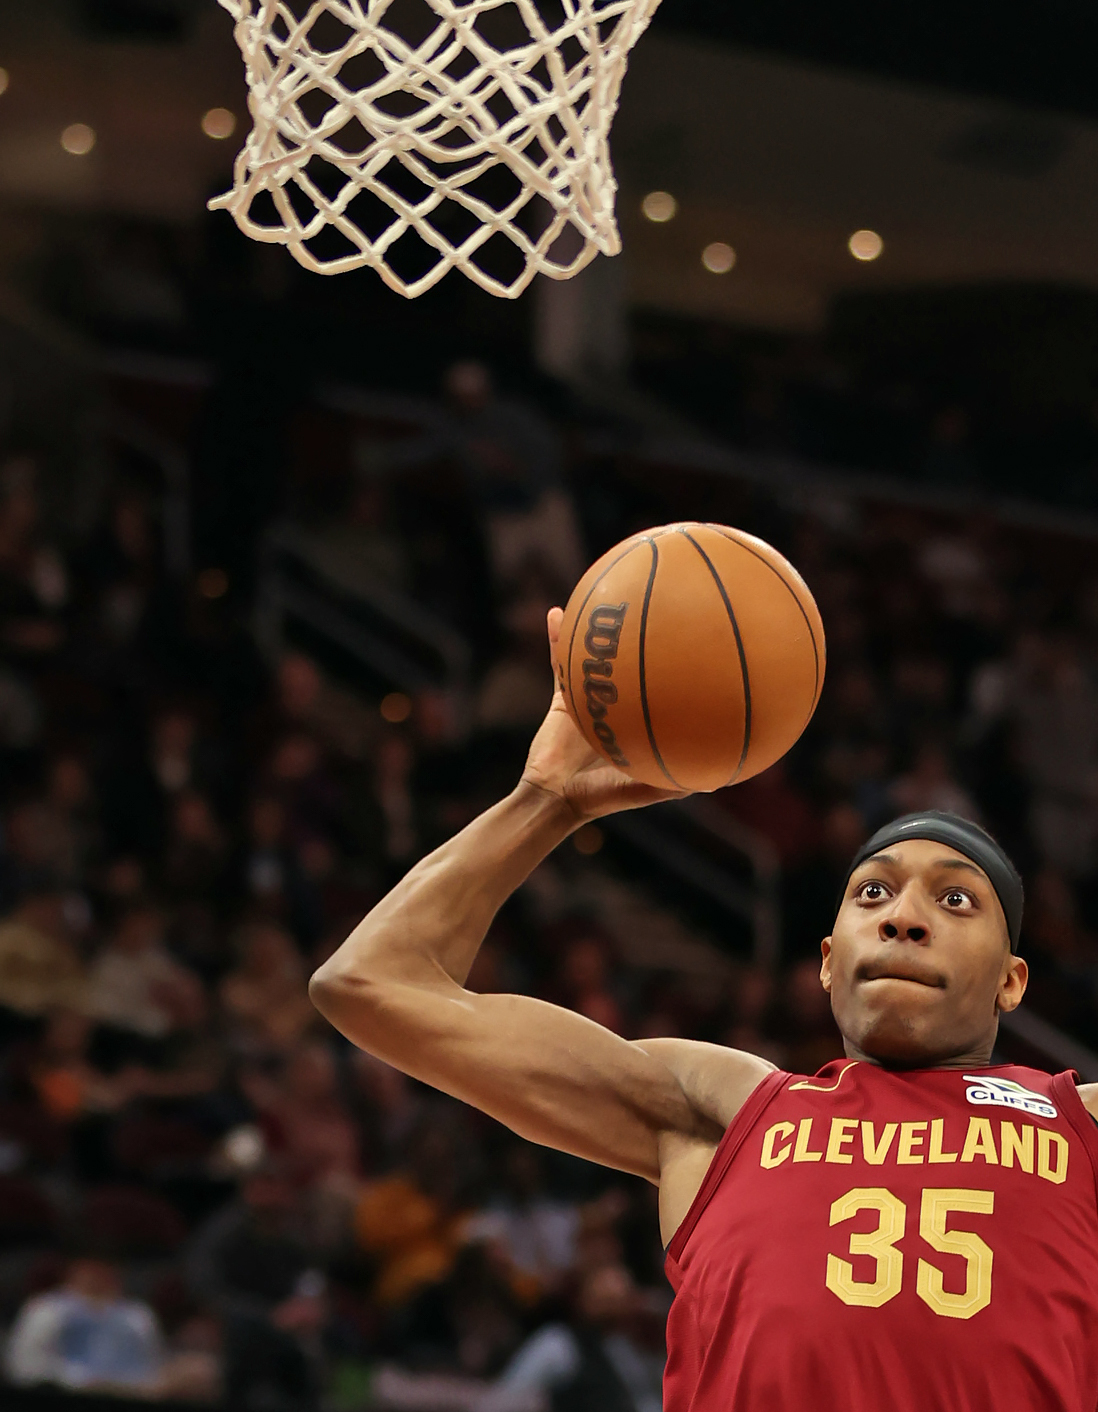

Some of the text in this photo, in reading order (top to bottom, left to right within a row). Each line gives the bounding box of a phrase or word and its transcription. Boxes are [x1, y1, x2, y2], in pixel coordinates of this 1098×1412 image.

[970, 1090, 1054, 1115] CLIFFS
[760, 1116, 1069, 1185] CLEVELAND
[825, 1187, 994, 1320] 35
